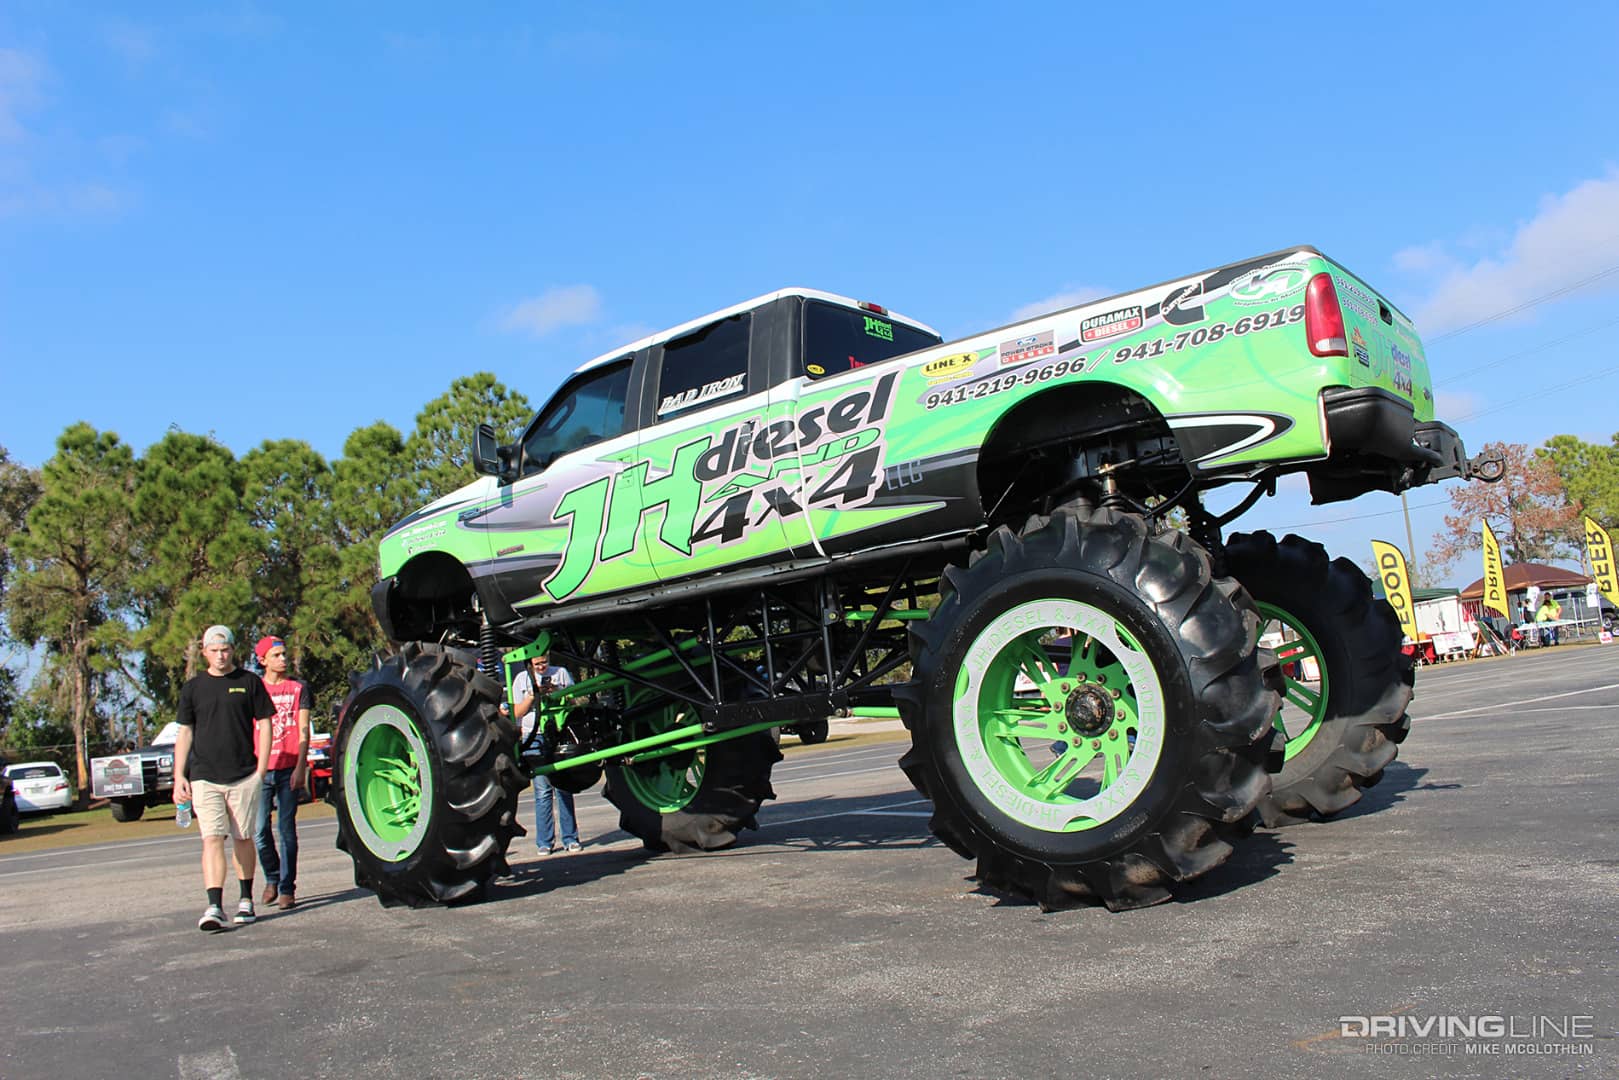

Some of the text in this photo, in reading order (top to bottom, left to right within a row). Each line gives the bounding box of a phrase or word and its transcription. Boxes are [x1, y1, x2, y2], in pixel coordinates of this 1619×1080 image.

[1082, 307, 1140, 331] DURAMAX
[1095, 321, 1129, 337] DIESEL
[926, 357, 1086, 410] 941-219-9696
[1114, 304, 1306, 364] 941-708-6919
[699, 372, 747, 399] IRON
[695, 371, 899, 481] diesel
[544, 436, 712, 601] JH
[988, 608, 1046, 648] DIESEL
[1136, 690, 1156, 760] DIESEL
